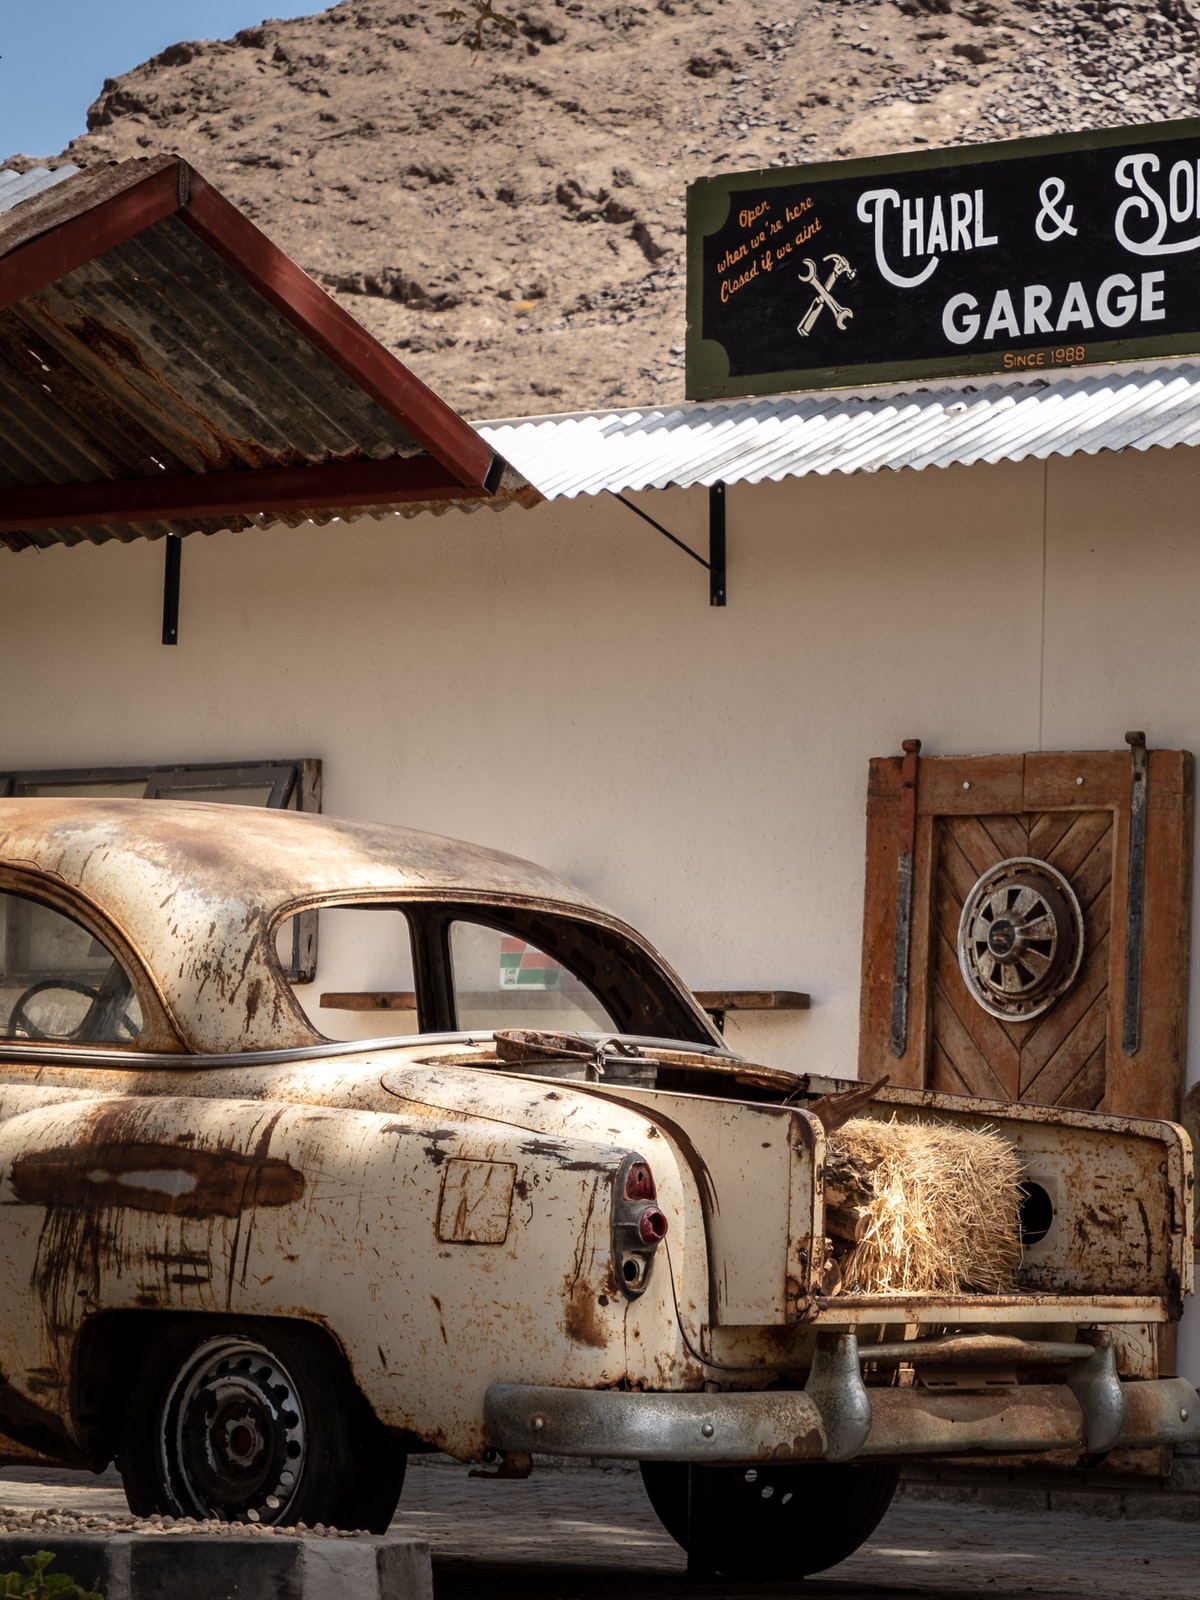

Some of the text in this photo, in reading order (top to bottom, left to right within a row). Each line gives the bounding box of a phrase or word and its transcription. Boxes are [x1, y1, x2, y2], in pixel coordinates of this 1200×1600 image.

[717, 197, 815, 273] when we're here
[738, 200, 771, 228] Open
[1035, 176, 1078, 242] &
[720, 217, 822, 303] Closed if we aint
[942, 270, 1166, 344] GARAGE
[1003, 346, 1085, 369] SINCE 1988
